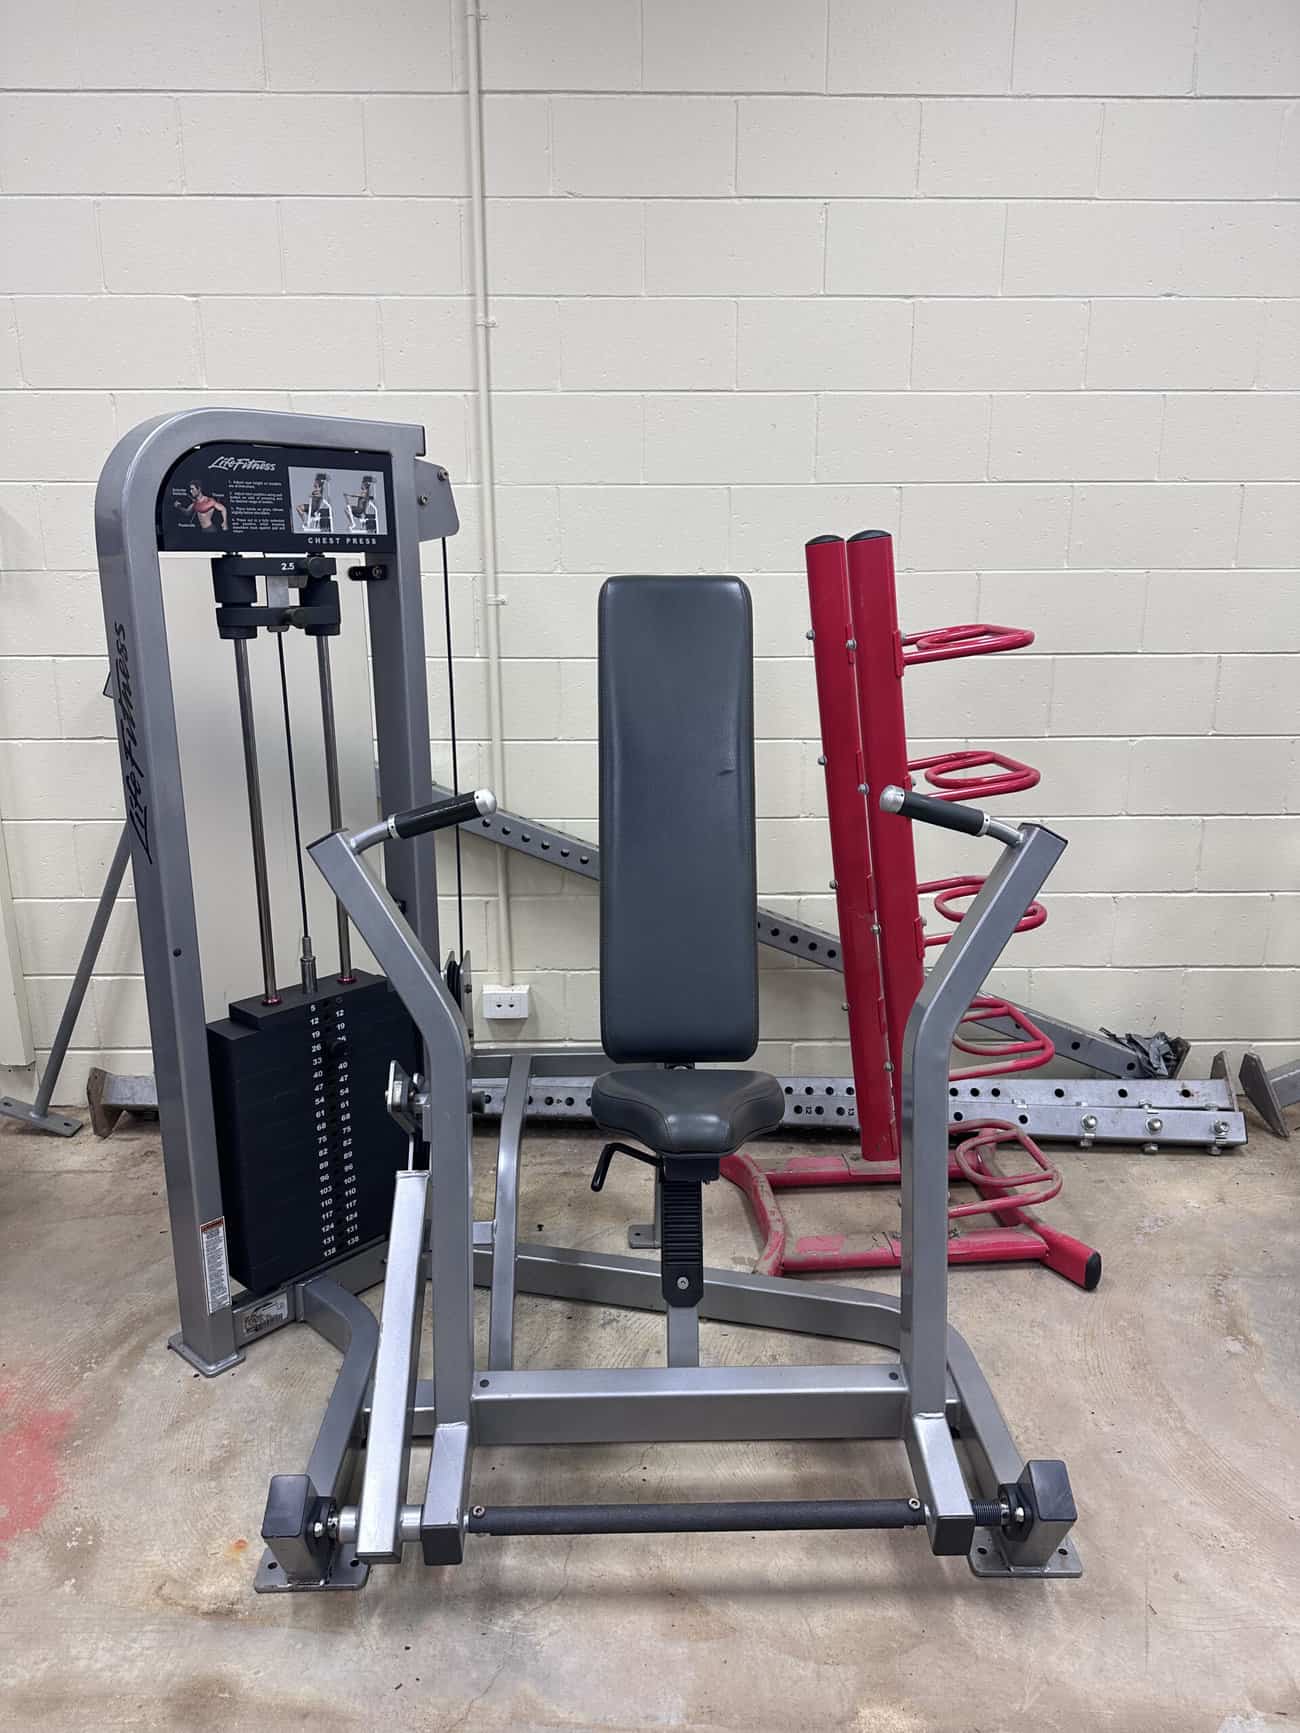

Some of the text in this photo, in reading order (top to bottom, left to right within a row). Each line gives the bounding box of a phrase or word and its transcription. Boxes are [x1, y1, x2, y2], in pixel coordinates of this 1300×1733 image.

[280, 562, 295, 570] 2.5
[336, 1009, 344, 1017] 12
[310, 1017, 319, 1025] 12
[336, 1022, 345, 1031] 19
[311, 1030, 320, 1039] 19
[311, 1043, 321, 1052] 26
[312, 1057, 322, 1066] 33
[338, 1061, 348, 1070] 40
[313, 1070, 323, 1078] 40
[339, 1074, 349, 1082] 47
[314, 1083, 324, 1092] 47
[339, 1087, 349, 1096] 54
[314, 1096, 325, 1105] 54
[340, 1099, 349, 1109] 61
[315, 1109, 325, 1118] 61
[342, 1125, 352, 1134] 75
[317, 1135, 327, 1144] 75
[344, 1174, 356, 1184] 103
[320, 1185, 332, 1195] 103
[345, 1187, 357, 1197] 110
[321, 1198, 333, 1208] 110
[346, 1199, 357, 1209] 117
[322, 1210, 333, 1220] 117
[321, 1222, 335, 1232] 124
[346, 1223, 358, 1234] 131
[323, 1234, 335, 1245] 131
[323, 1247, 336, 1257] 138
